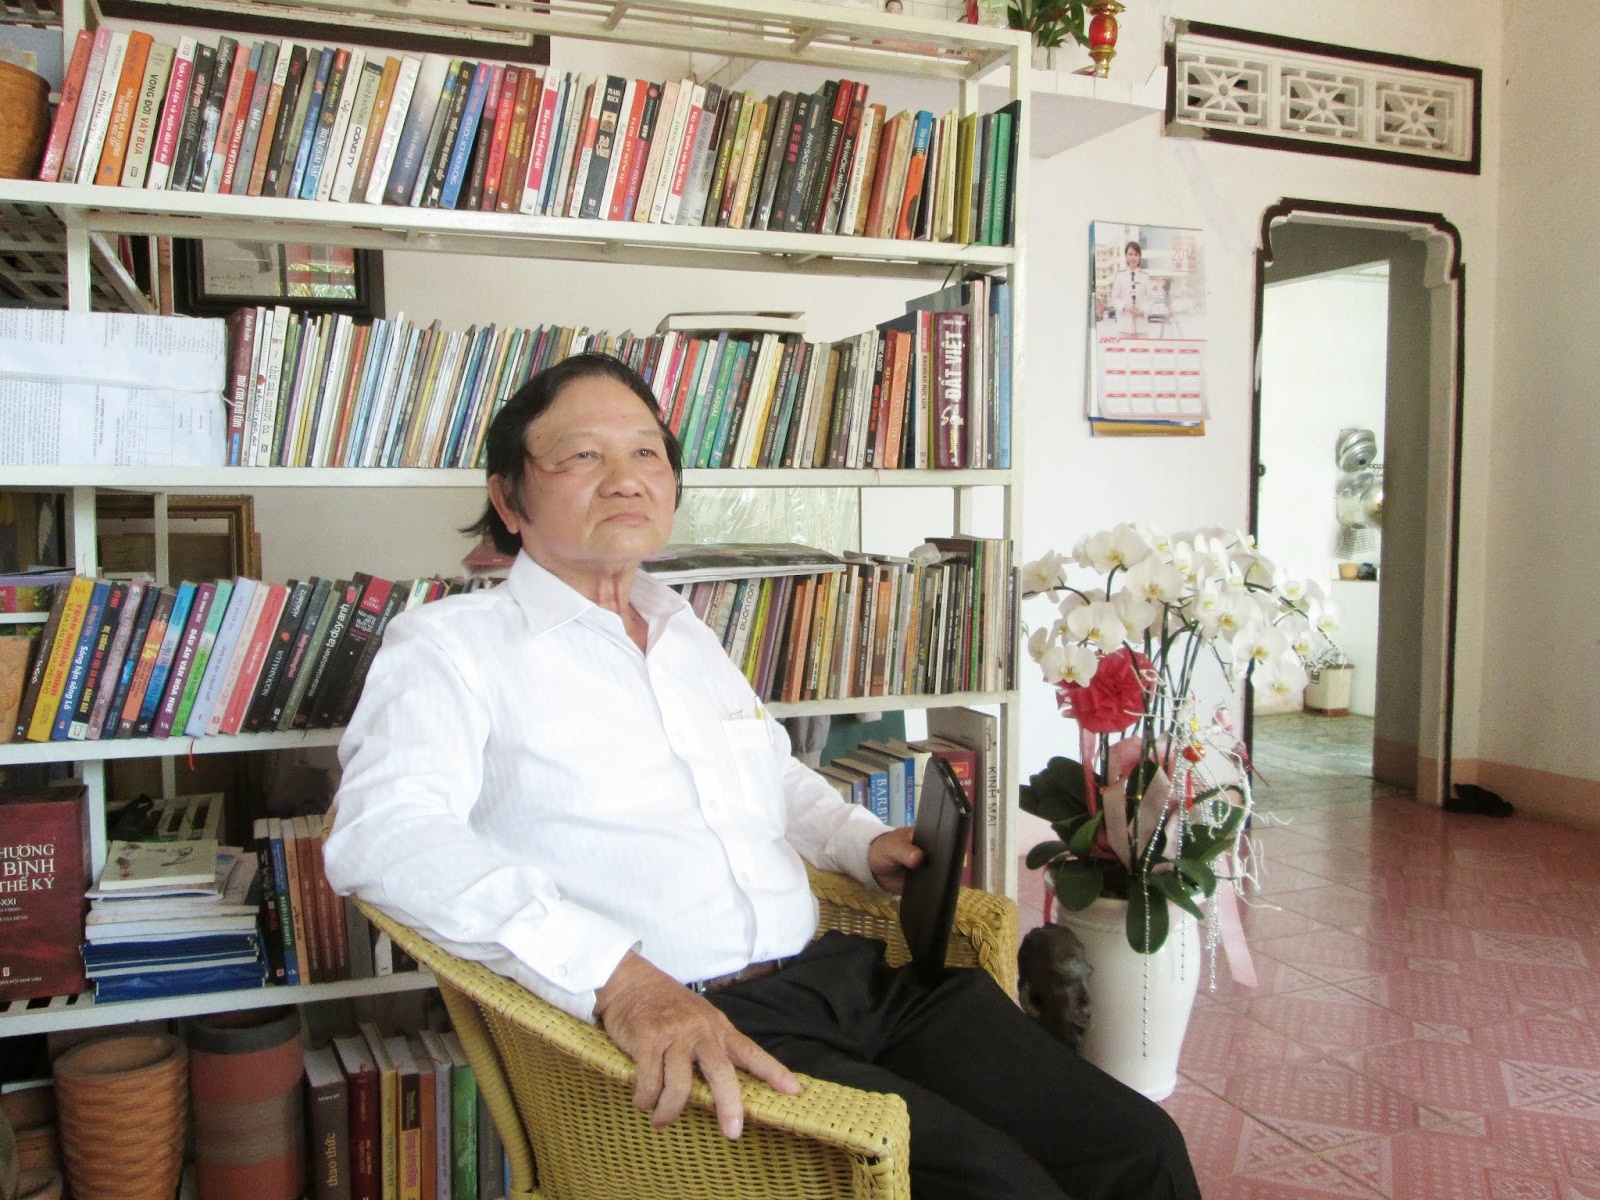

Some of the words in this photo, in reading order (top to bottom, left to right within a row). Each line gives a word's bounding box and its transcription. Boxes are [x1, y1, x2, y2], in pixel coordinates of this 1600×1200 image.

[346, 155, 356, 168] TY
[1172, 248, 1196, 261] 2014
[941, 330, 964, 363] VIỆT
[938, 368, 961, 401] ĐẤT
[710, 388, 723, 417] CASUAL
[232, 415, 243, 427] tim
[262, 424, 271, 434] ba
[68, 602, 82, 630] TRẦN
[335, 601, 349, 621] anh
[185, 627, 198, 645] DẤU
[329, 620, 344, 638] duy
[58, 632, 73, 667] NHUẬN
[140, 640, 160, 662] 14
[181, 645, 193, 659] ẤN
[324, 637, 336, 648] tạ
[75, 644, 88, 664] Sóng
[71, 665, 82, 680] hận
[176, 658, 189, 677] VĂN
[49, 670, 62, 696] MINH
[65, 679, 78, 699] sông
[170, 677, 183, 696] HÓA
[62, 699, 72, 710] Lô
[165, 696, 177, 714] HUẾ
[987, 766, 996, 797] KINH
[986, 802, 996, 826] MAI
[4, 858, 55, 876] BÌNH
[325, 1132, 338, 1158] thức
[326, 1162, 339, 1186] thao
